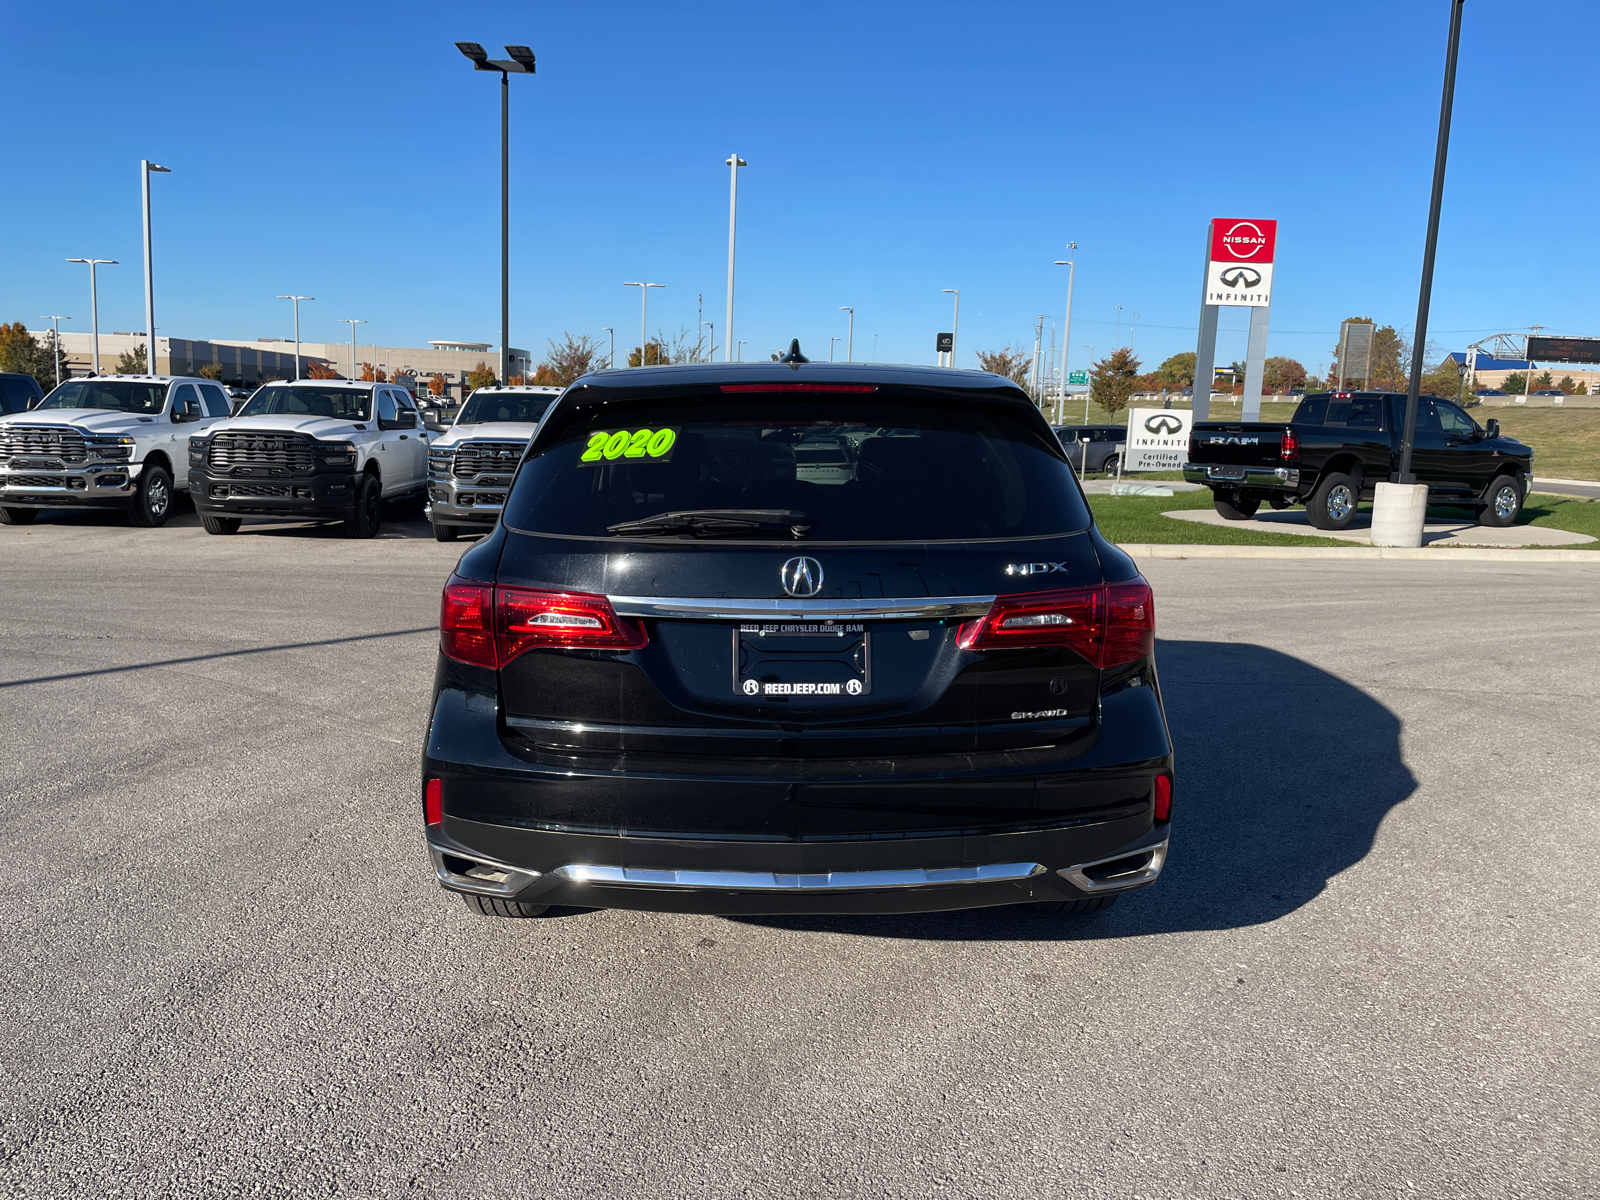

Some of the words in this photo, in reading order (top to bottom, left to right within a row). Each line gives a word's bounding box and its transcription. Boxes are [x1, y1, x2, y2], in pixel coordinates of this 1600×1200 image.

[1223, 236, 1266, 244] NISSAN
[1210, 293, 1268, 302] INFINITI
[233, 441, 284, 449] RAM
[581, 428, 676, 462] 2020
[1136, 438, 1187, 447] INFINITI
[1210, 436, 1259, 446] RAM
[1143, 453, 1178, 461] Certified
[1138, 461, 1181, 469] Pre-Owned
[1004, 562, 1069, 576] MDX
[740, 624, 760, 632] REED
[762, 624, 779, 632] JEEP
[780, 624, 818, 633] CHRYSLER
[820, 624, 844, 632] DODGE
[846, 624, 864, 632] RAM
[764, 683, 840, 694] REEDJEEP.COM
